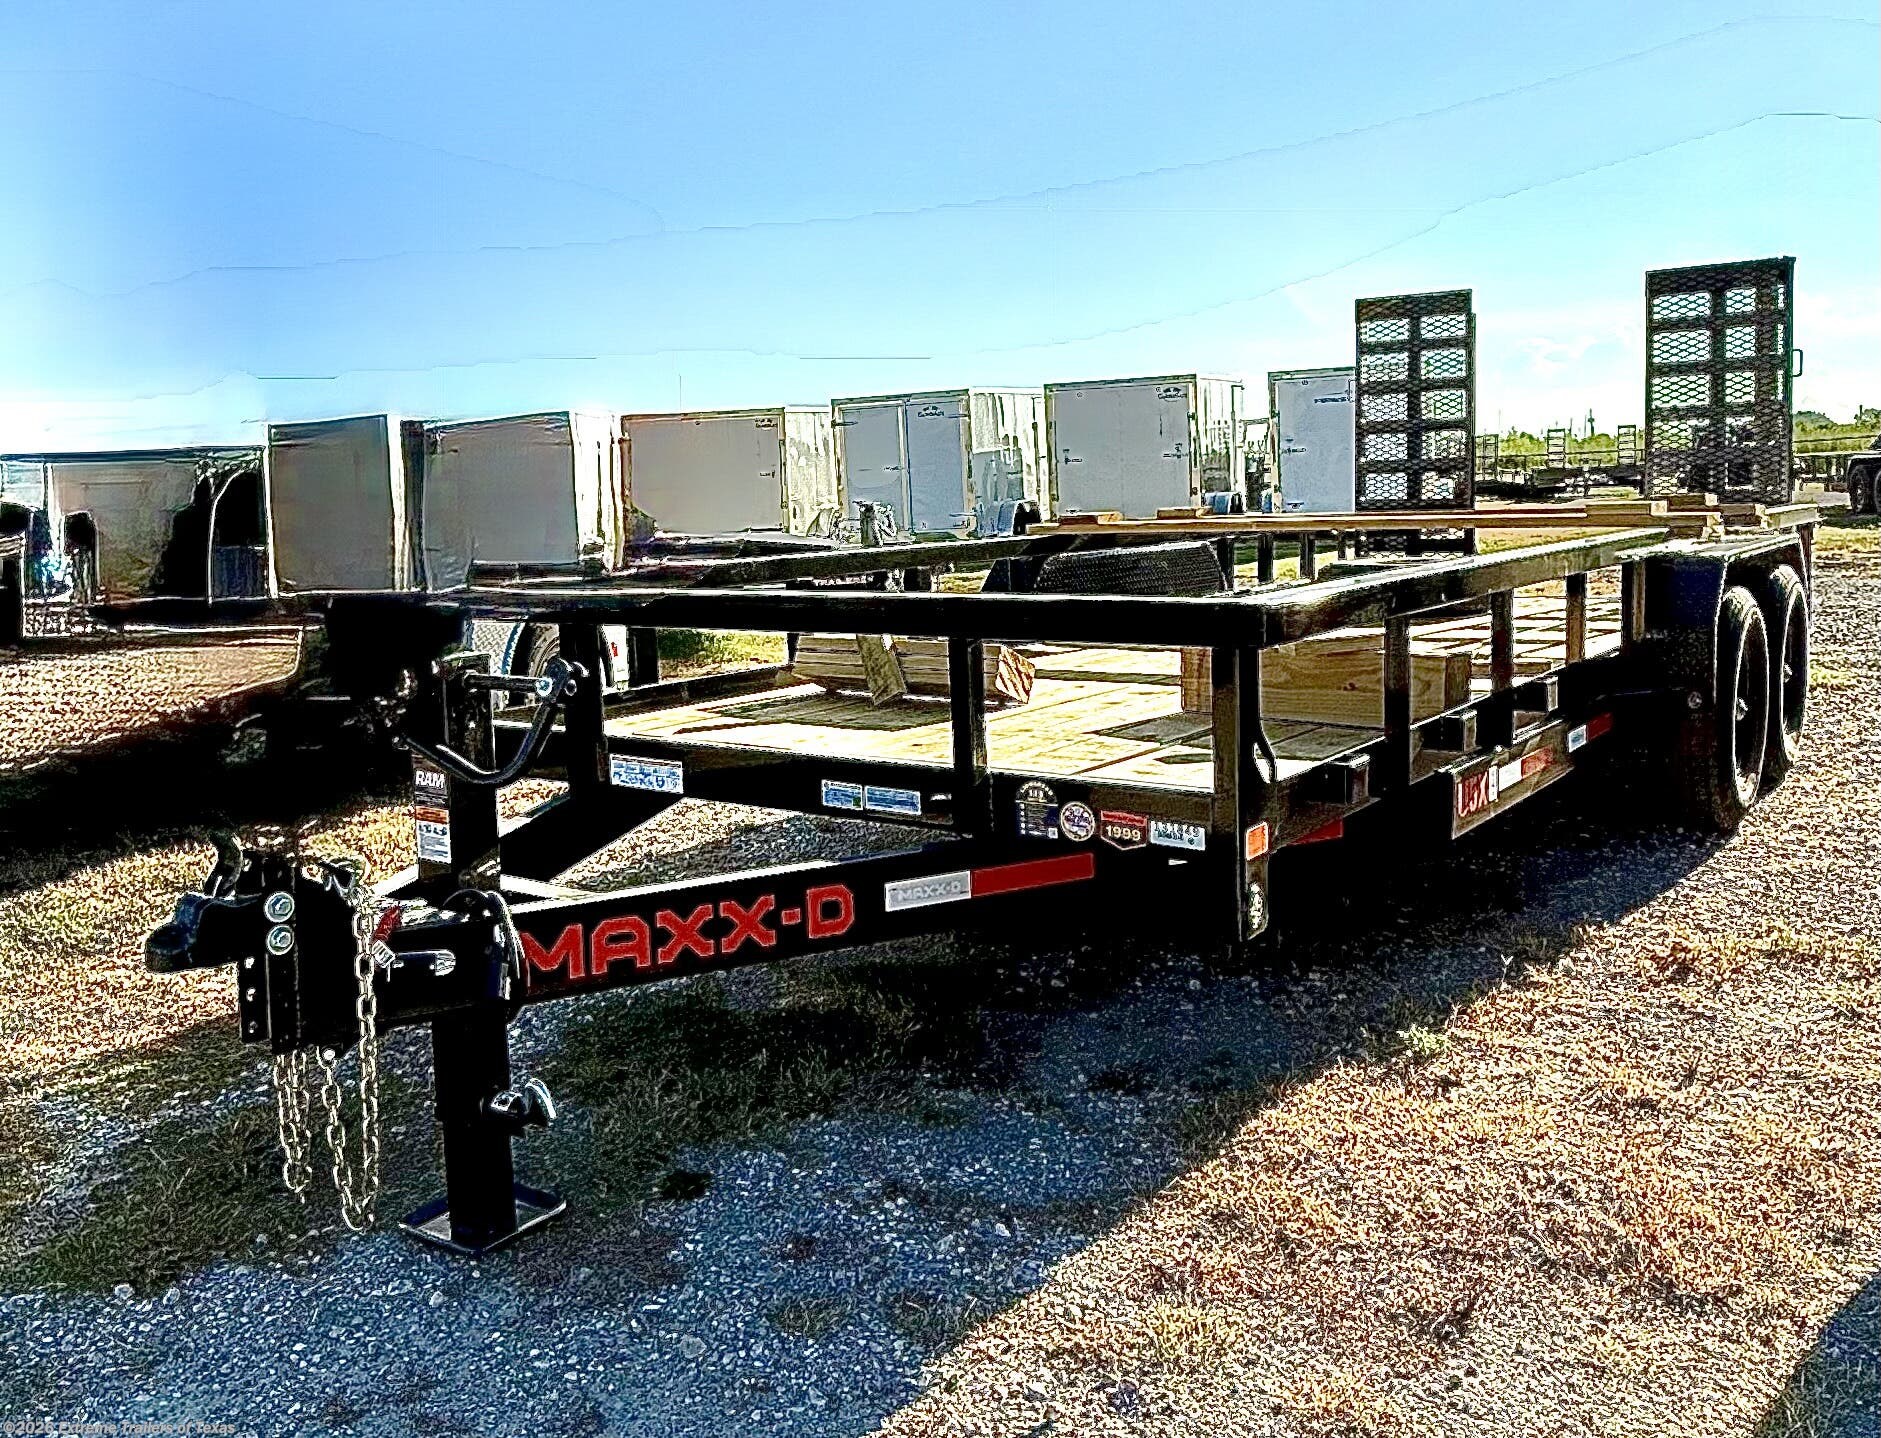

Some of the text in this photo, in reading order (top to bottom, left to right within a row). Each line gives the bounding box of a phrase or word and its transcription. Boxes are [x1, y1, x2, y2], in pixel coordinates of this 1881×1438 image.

[415, 770, 445, 788] RAM
[1105, 825, 1141, 841] 1999
[897, 881, 961, 901] MAXX-D
[519, 884, 854, 979] MAXX-D
